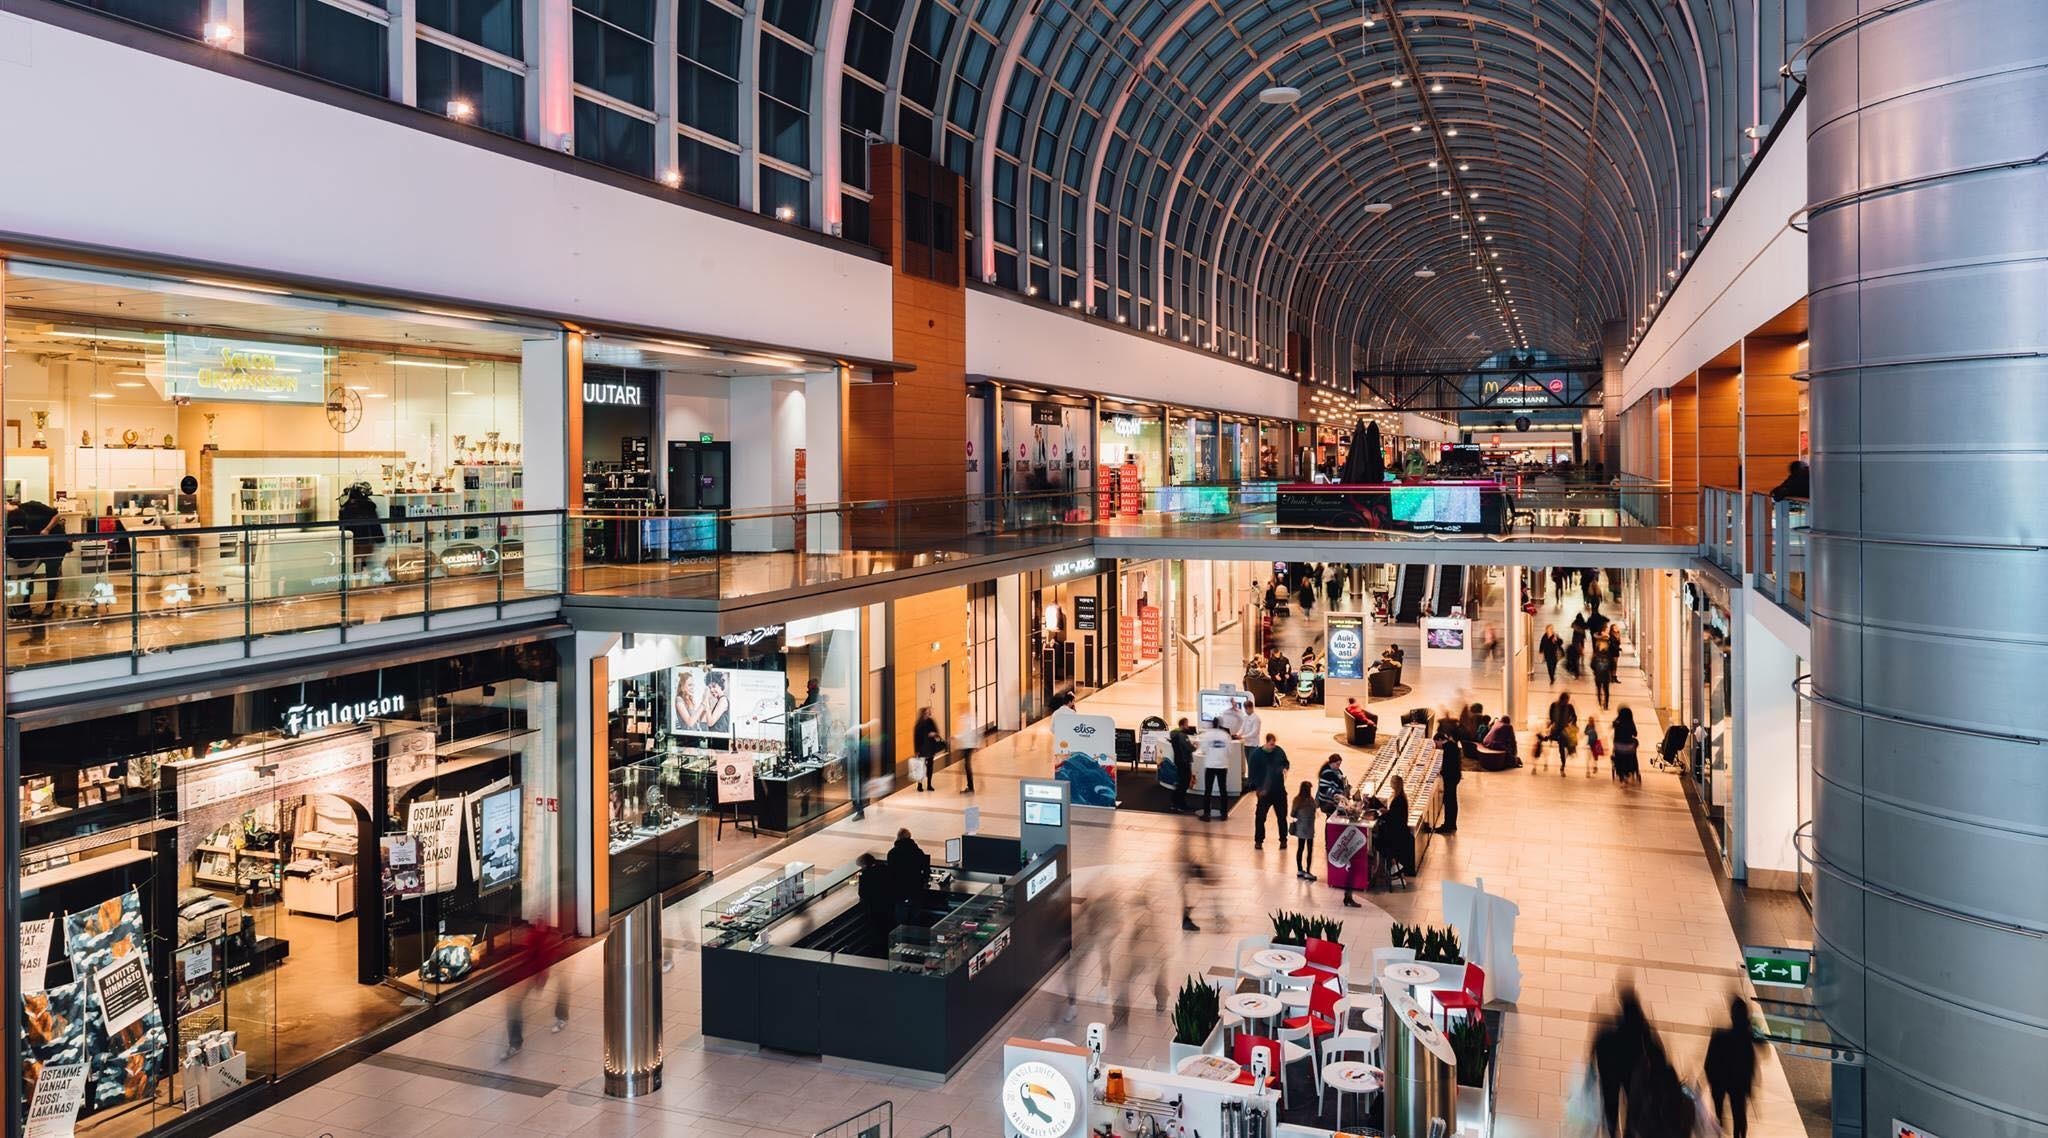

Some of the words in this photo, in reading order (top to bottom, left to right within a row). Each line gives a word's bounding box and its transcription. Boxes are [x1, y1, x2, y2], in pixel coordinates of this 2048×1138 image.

[583, 383, 640, 405] UUTARI
[1497, 396, 1548, 404] STOCKMANN
[1142, 611, 1158, 619] SALE!
[286, 694, 405, 735] Finlayson
[1073, 723, 1096, 734] elisa
[413, 804, 454, 821] OSTAMME
[412, 819, 447, 835] VANHAT
[105, 963, 138, 988] HYVITYS-
[103, 970, 141, 998] HINNASTO
[41, 1066, 82, 1081] OSTAMME
[39, 1079, 72, 1093] VANHAT
[35, 1093, 62, 1106] PUSSI-
[31, 1102, 74, 1118] LAKANASI
